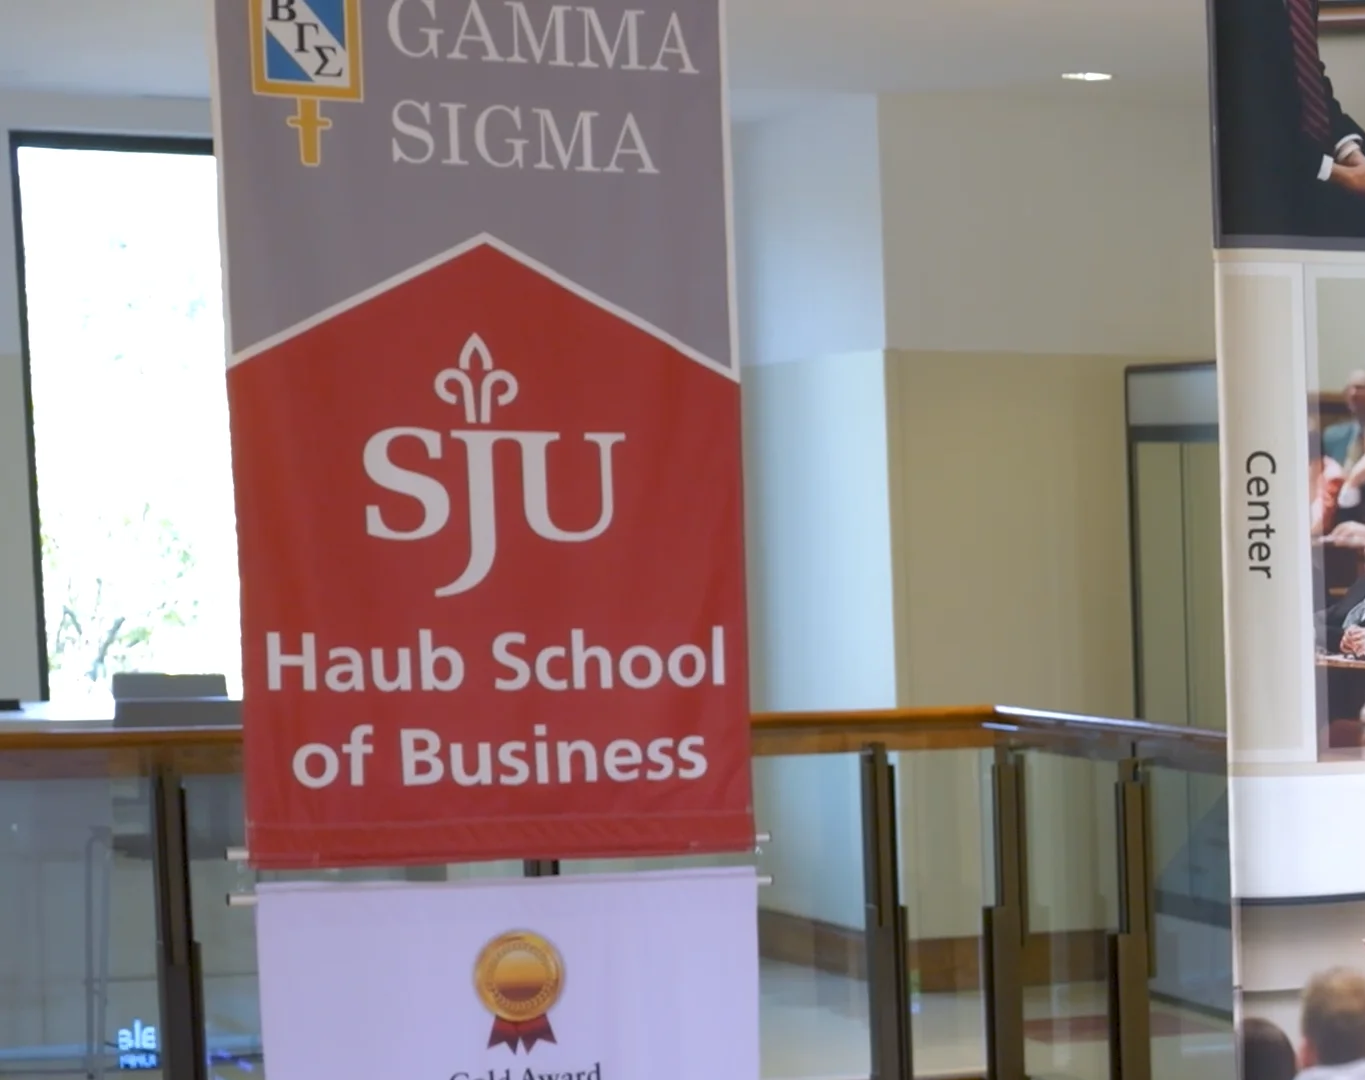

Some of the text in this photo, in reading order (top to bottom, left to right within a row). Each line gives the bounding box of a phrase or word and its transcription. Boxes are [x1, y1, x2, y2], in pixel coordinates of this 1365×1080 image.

[388, 0, 699, 74] GAMMA
[391, 100, 659, 174] SIGMA
[363, 425, 626, 598] SJU
[1246, 449, 1277, 580] Center
[266, 625, 726, 692] Haub School
[292, 724, 708, 790] of Business
